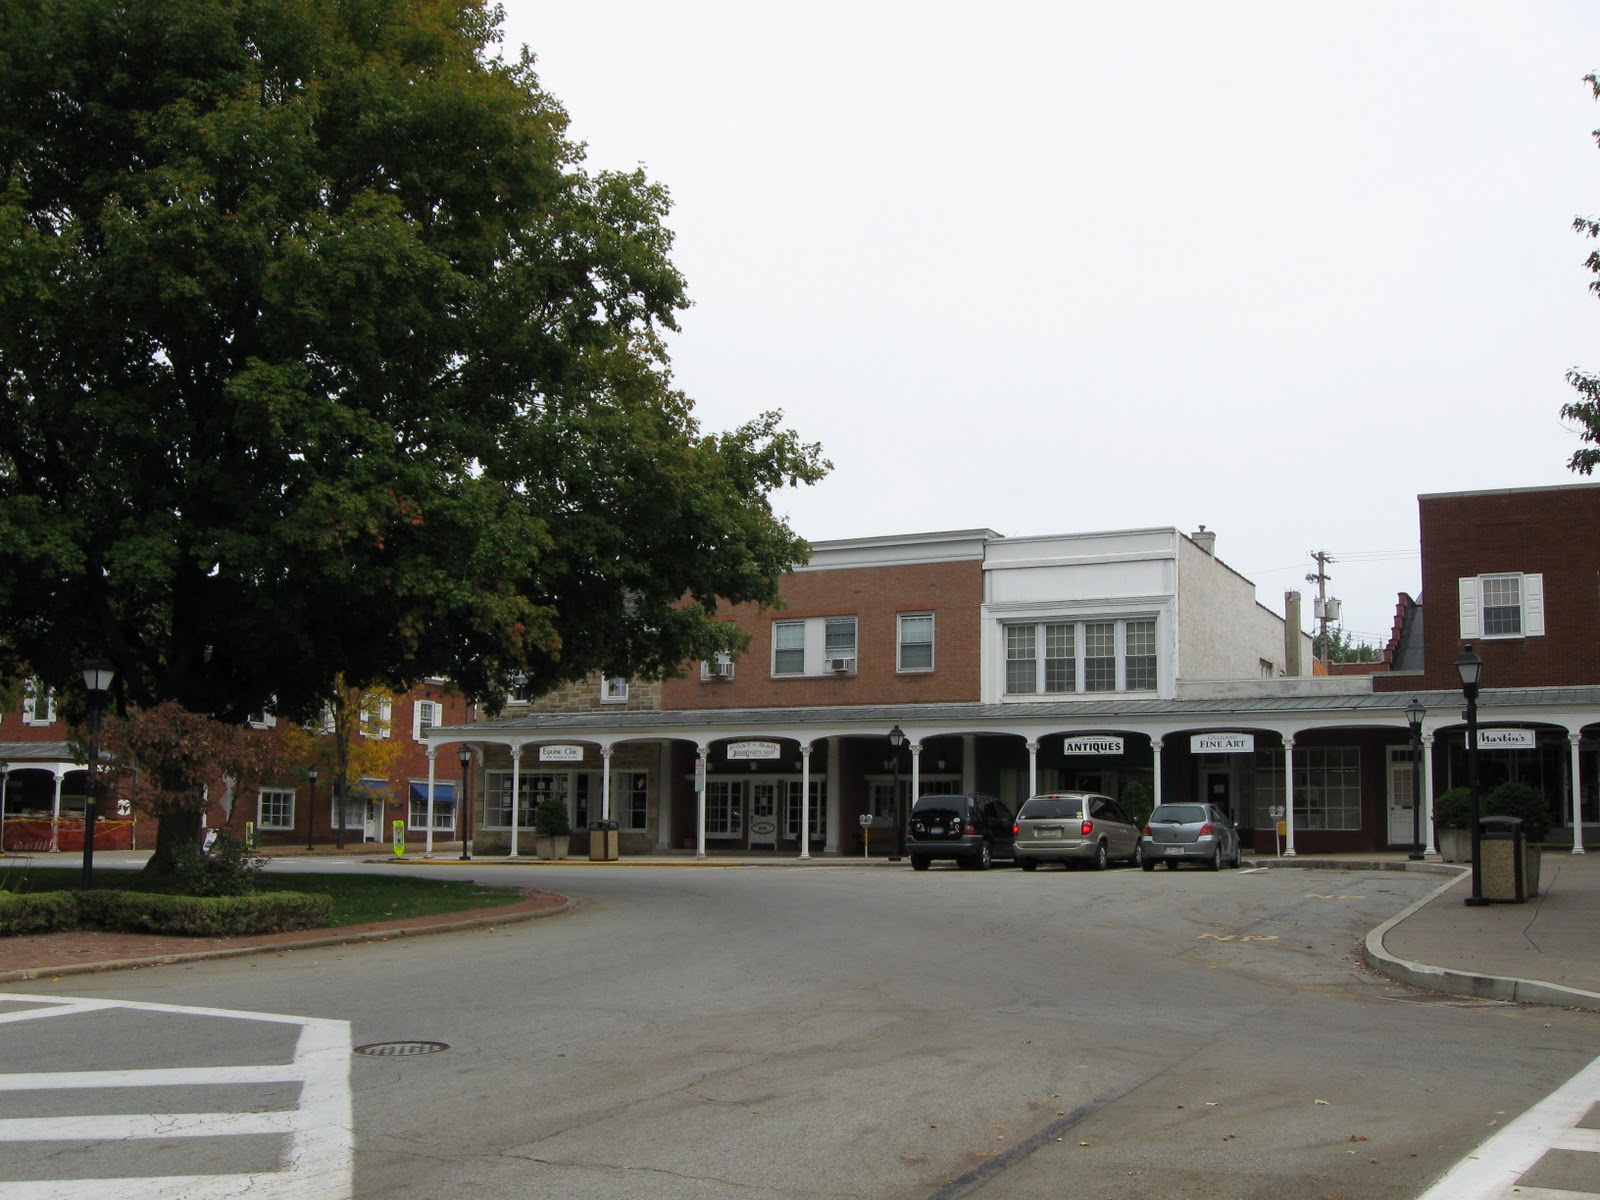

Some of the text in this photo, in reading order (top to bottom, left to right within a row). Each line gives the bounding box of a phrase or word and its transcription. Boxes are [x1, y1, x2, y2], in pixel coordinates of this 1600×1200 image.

[1479, 732, 1525, 743] Martin's
[1066, 742, 1122, 753] ANTIQUES
[1200, 740, 1246, 748] FINE ART
